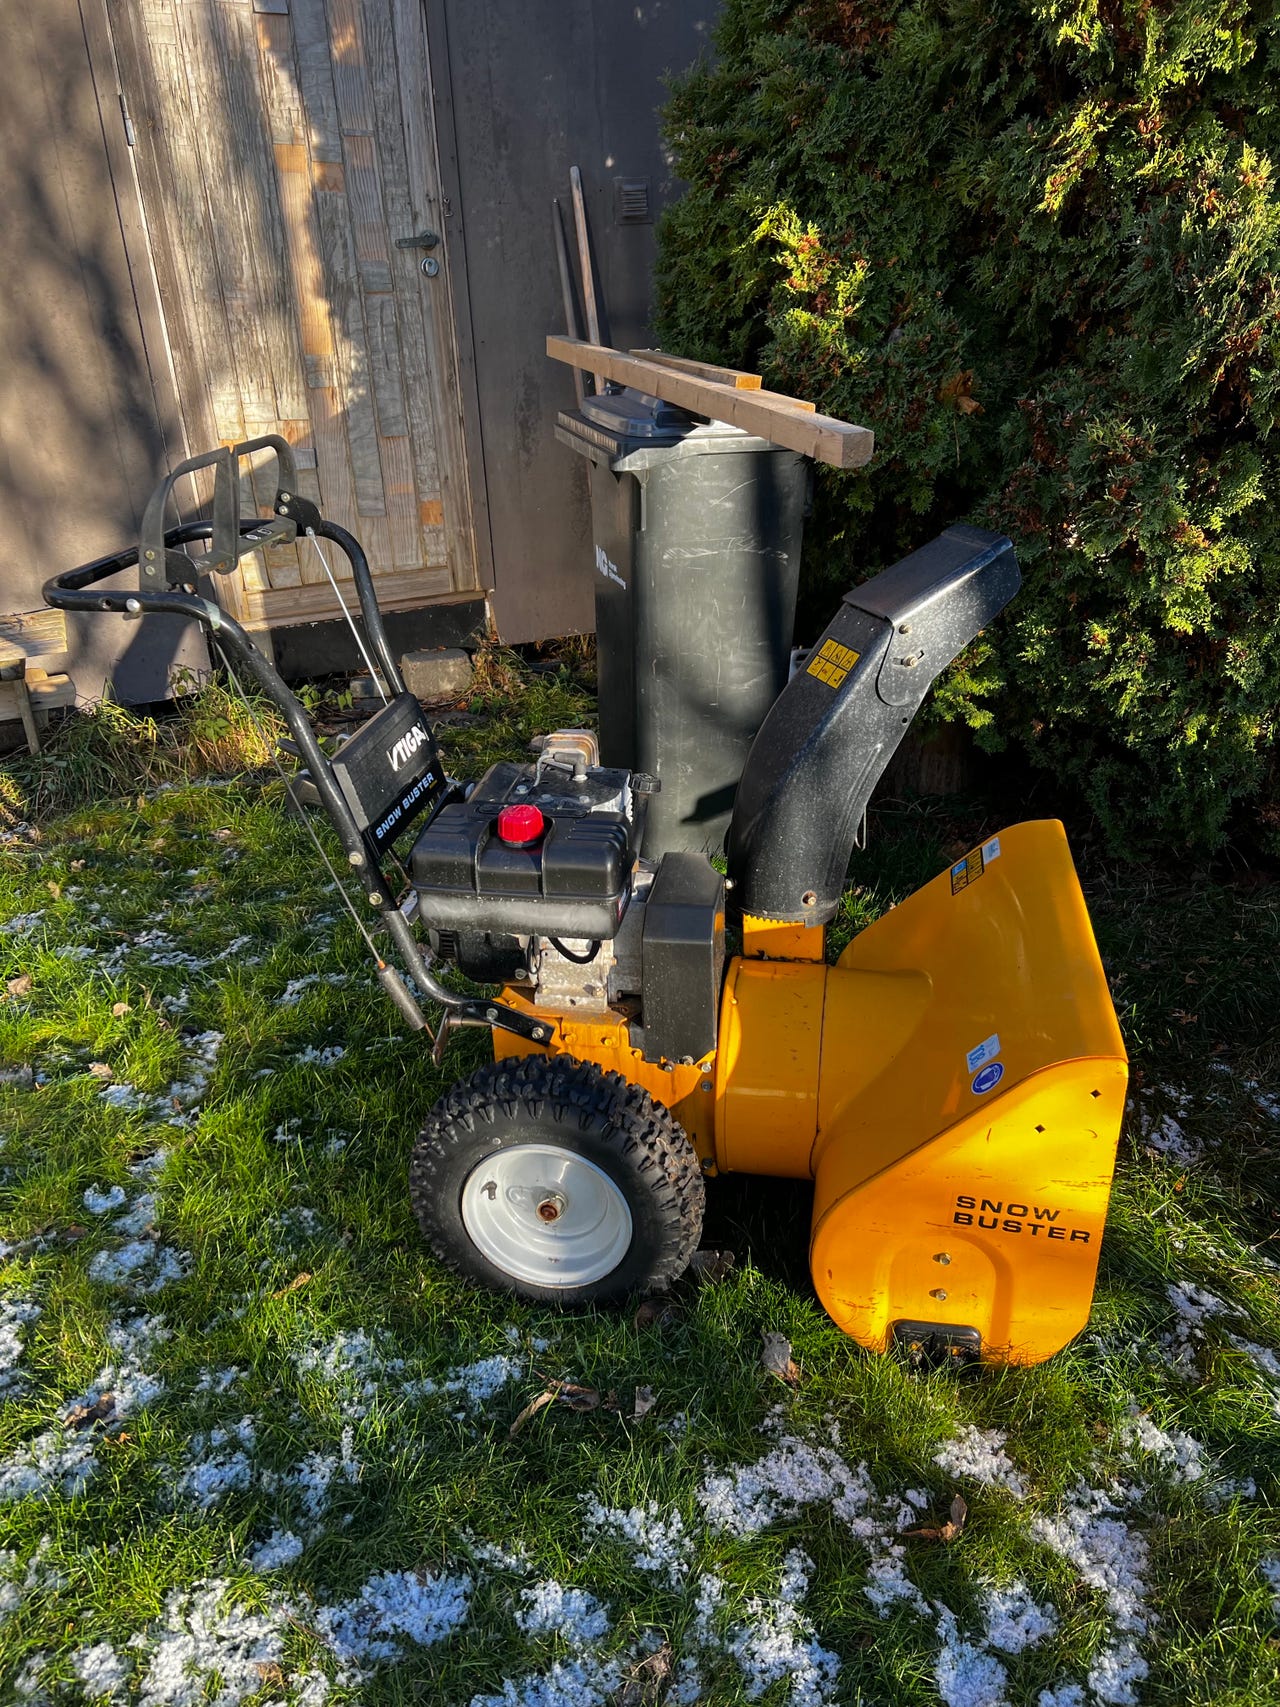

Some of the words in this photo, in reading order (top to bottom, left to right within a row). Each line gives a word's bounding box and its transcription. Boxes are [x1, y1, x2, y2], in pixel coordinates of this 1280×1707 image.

[375, 806, 402, 839] SNOW
[402, 772, 434, 810] BUSTER
[956, 1195, 1061, 1222] SNOW
[953, 1211, 1091, 1243] BUSTER
